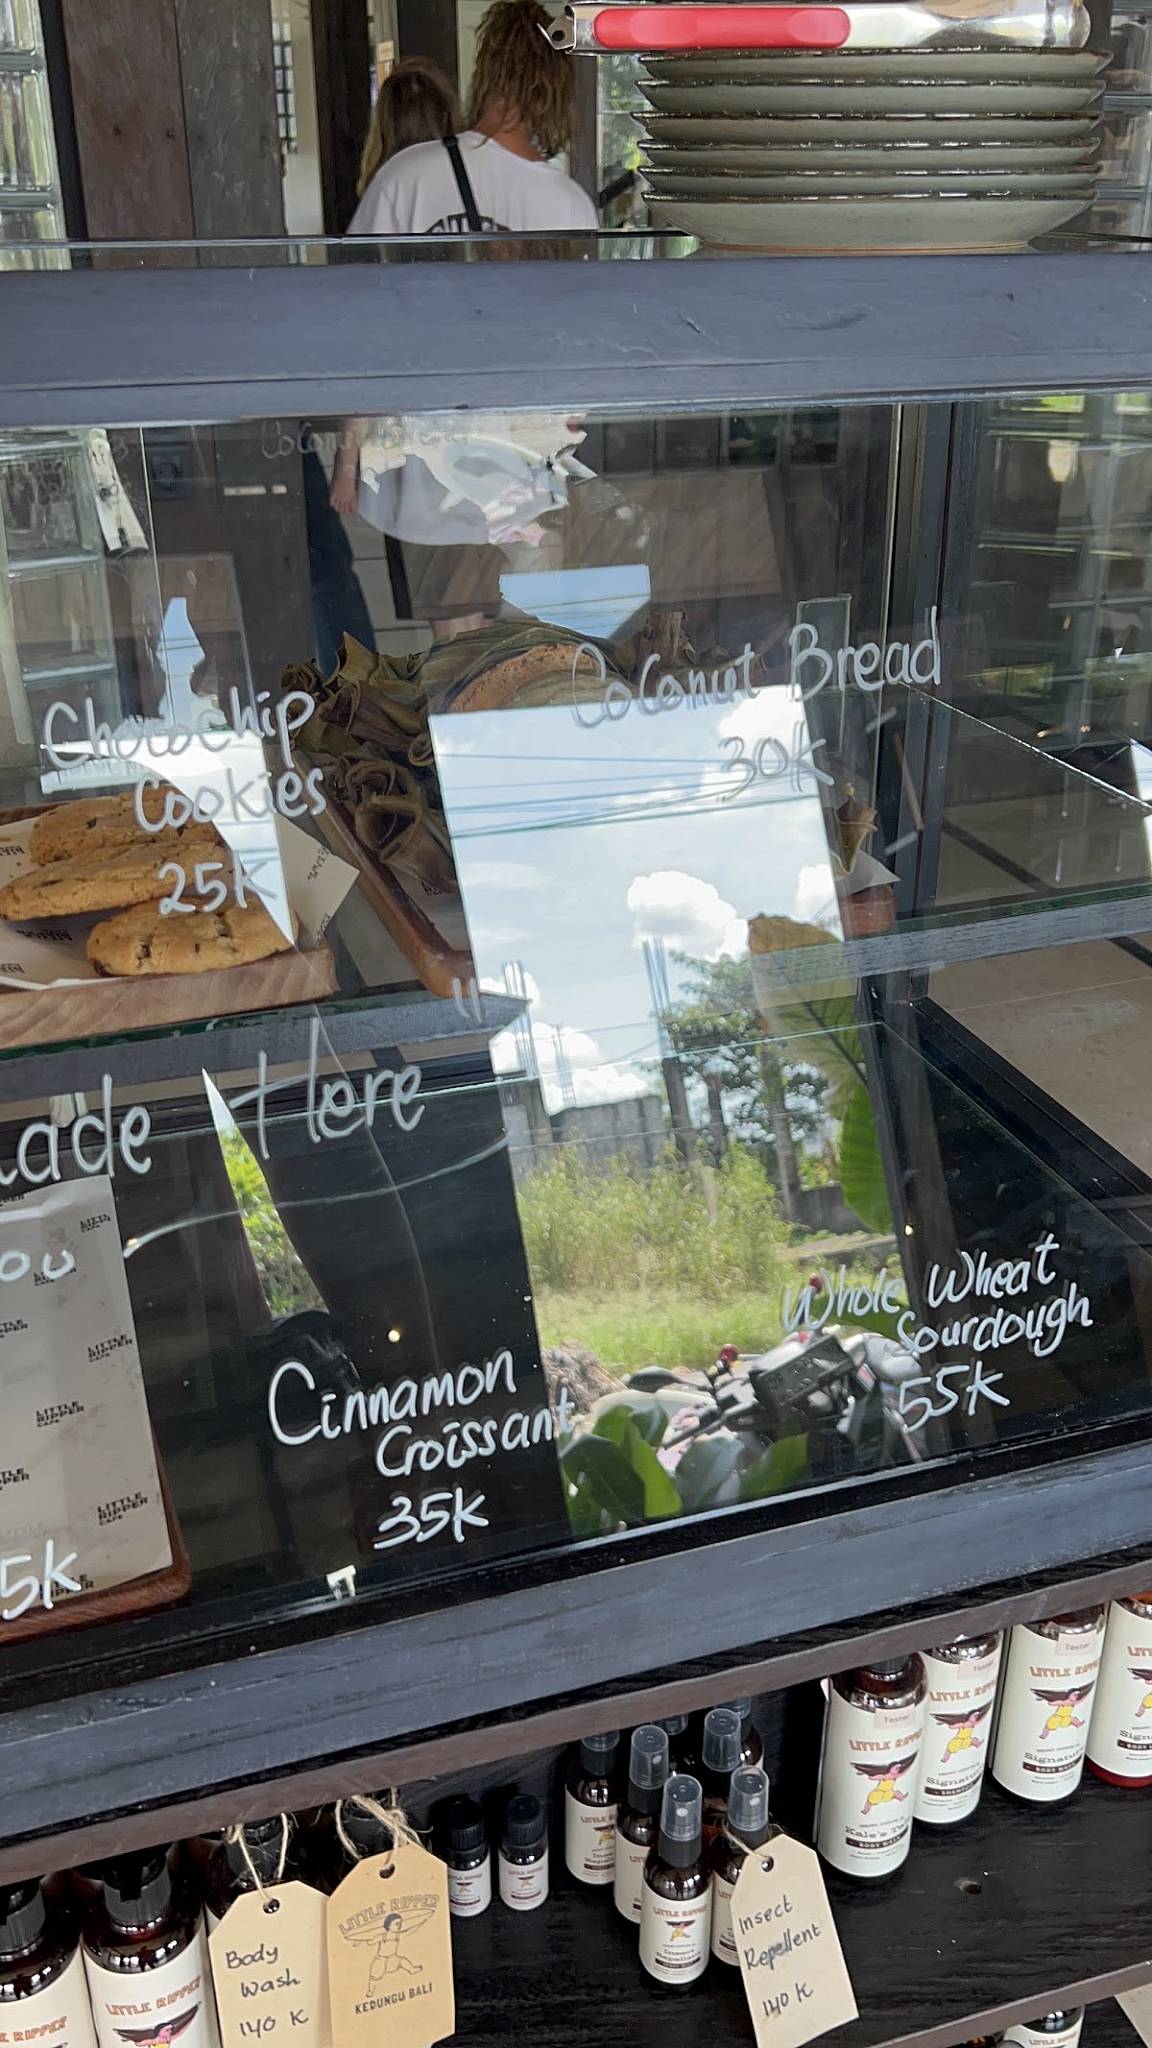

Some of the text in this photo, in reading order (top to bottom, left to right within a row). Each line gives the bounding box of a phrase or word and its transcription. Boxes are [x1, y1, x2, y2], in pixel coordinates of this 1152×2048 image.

[787, 605, 943, 702] Bread
[136, 767, 327, 832] Cookies
[0, 1016, 425, 1186] ade Here
[780, 1232, 1060, 1332] Whole Wheat
[897, 1281, 1094, 1358] Sourdough
[36, 1400, 80, 1416] LITTLE
[37, 1405, 85, 1423] RIPPER
[268, 1350, 518, 1446] Cinnamon
[375, 1386, 576, 1477] Croissant
[97, 1491, 142, 1513] LITTLE
[98, 1496, 149, 1520] RIPPER
[338, 1893, 441, 1936] LITTLE RIPPER
[739, 1894, 794, 1936] Insect
[225, 1943, 279, 1970] Body
[743, 1923, 822, 1971] Repellent
[240, 1967, 302, 1998] Wash
[355, 1982, 433, 2015] KEDUNGU BALI
[105, 2002, 152, 2017] LITTLE
[762, 1992, 790, 2017] 140
[239, 2015, 277, 2040] 140
